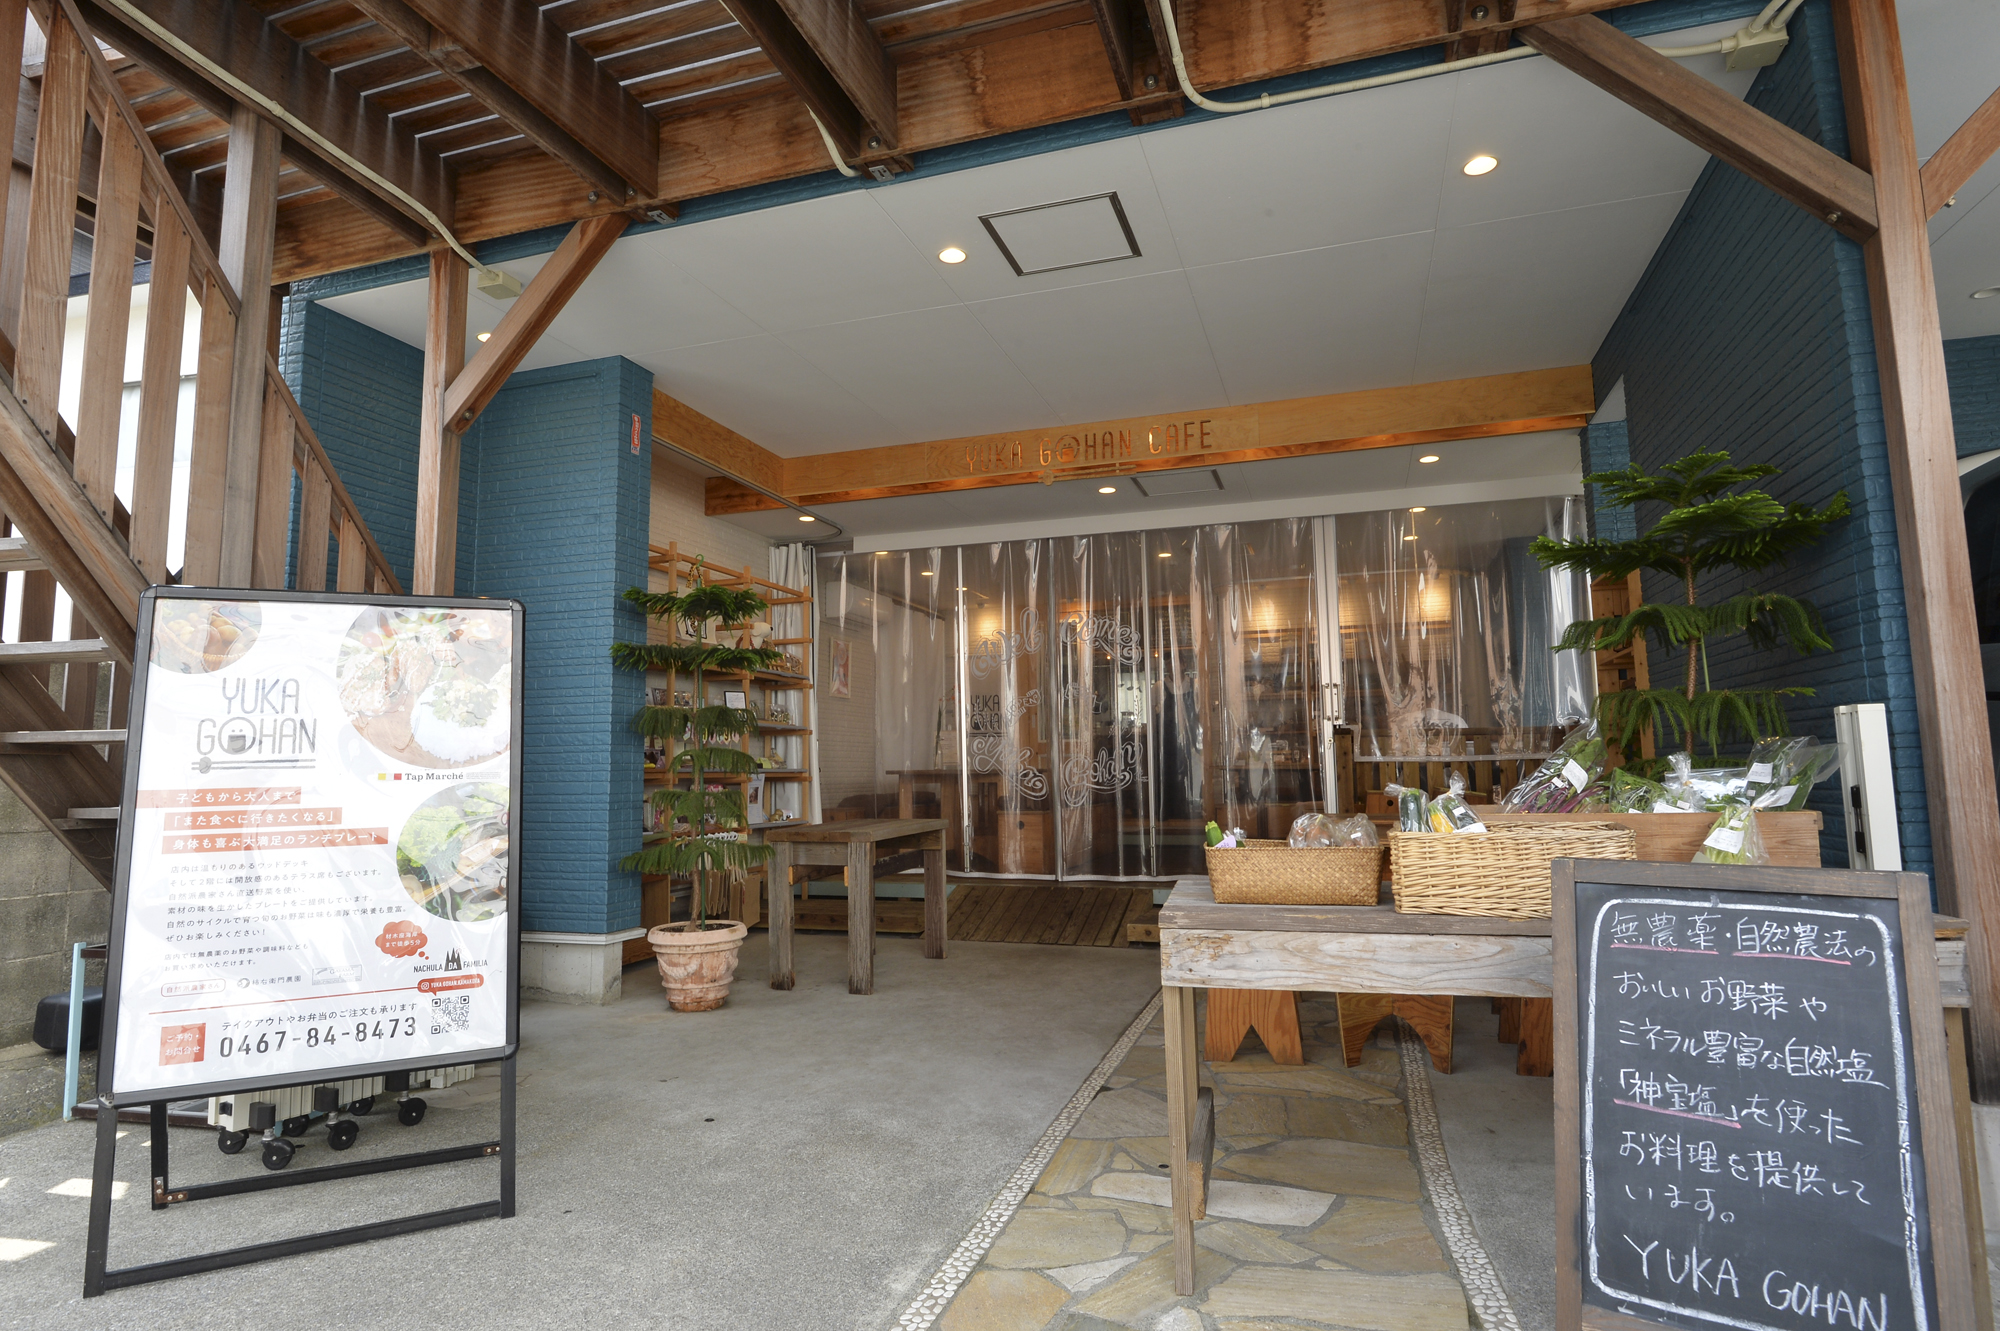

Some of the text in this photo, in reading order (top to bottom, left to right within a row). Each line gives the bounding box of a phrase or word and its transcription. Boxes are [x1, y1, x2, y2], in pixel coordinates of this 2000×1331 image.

[965, 419, 1212, 473] YUKA GOHAN CAFE
[222, 677, 300, 714] YUKA
[970, 694, 1000, 712] YUKA
[196, 716, 318, 755] GOHAN
[405, 772, 424, 782] Tap
[426, 771, 464, 781] Marché
[176, 790, 296, 804] 子どもから大人まで
[173, 811, 333, 827] 「また食べに行きたくなる」
[173, 832, 378, 851] 身体も喜ぶ大満足のランチプレート
[222, 1003, 417, 1031] テイクアウトやお弁当のご注文も承ります
[219, 1016, 416, 1058] 0467-84-8473
[1619, 1018, 1891, 1089] ミネラル豊富な自然塩
[1620, 1131, 1872, 1205] お料理を提供して
[1625, 1184, 1735, 1223] います。
[1623, 1234, 1888, 1331] YUKA GOHAN
